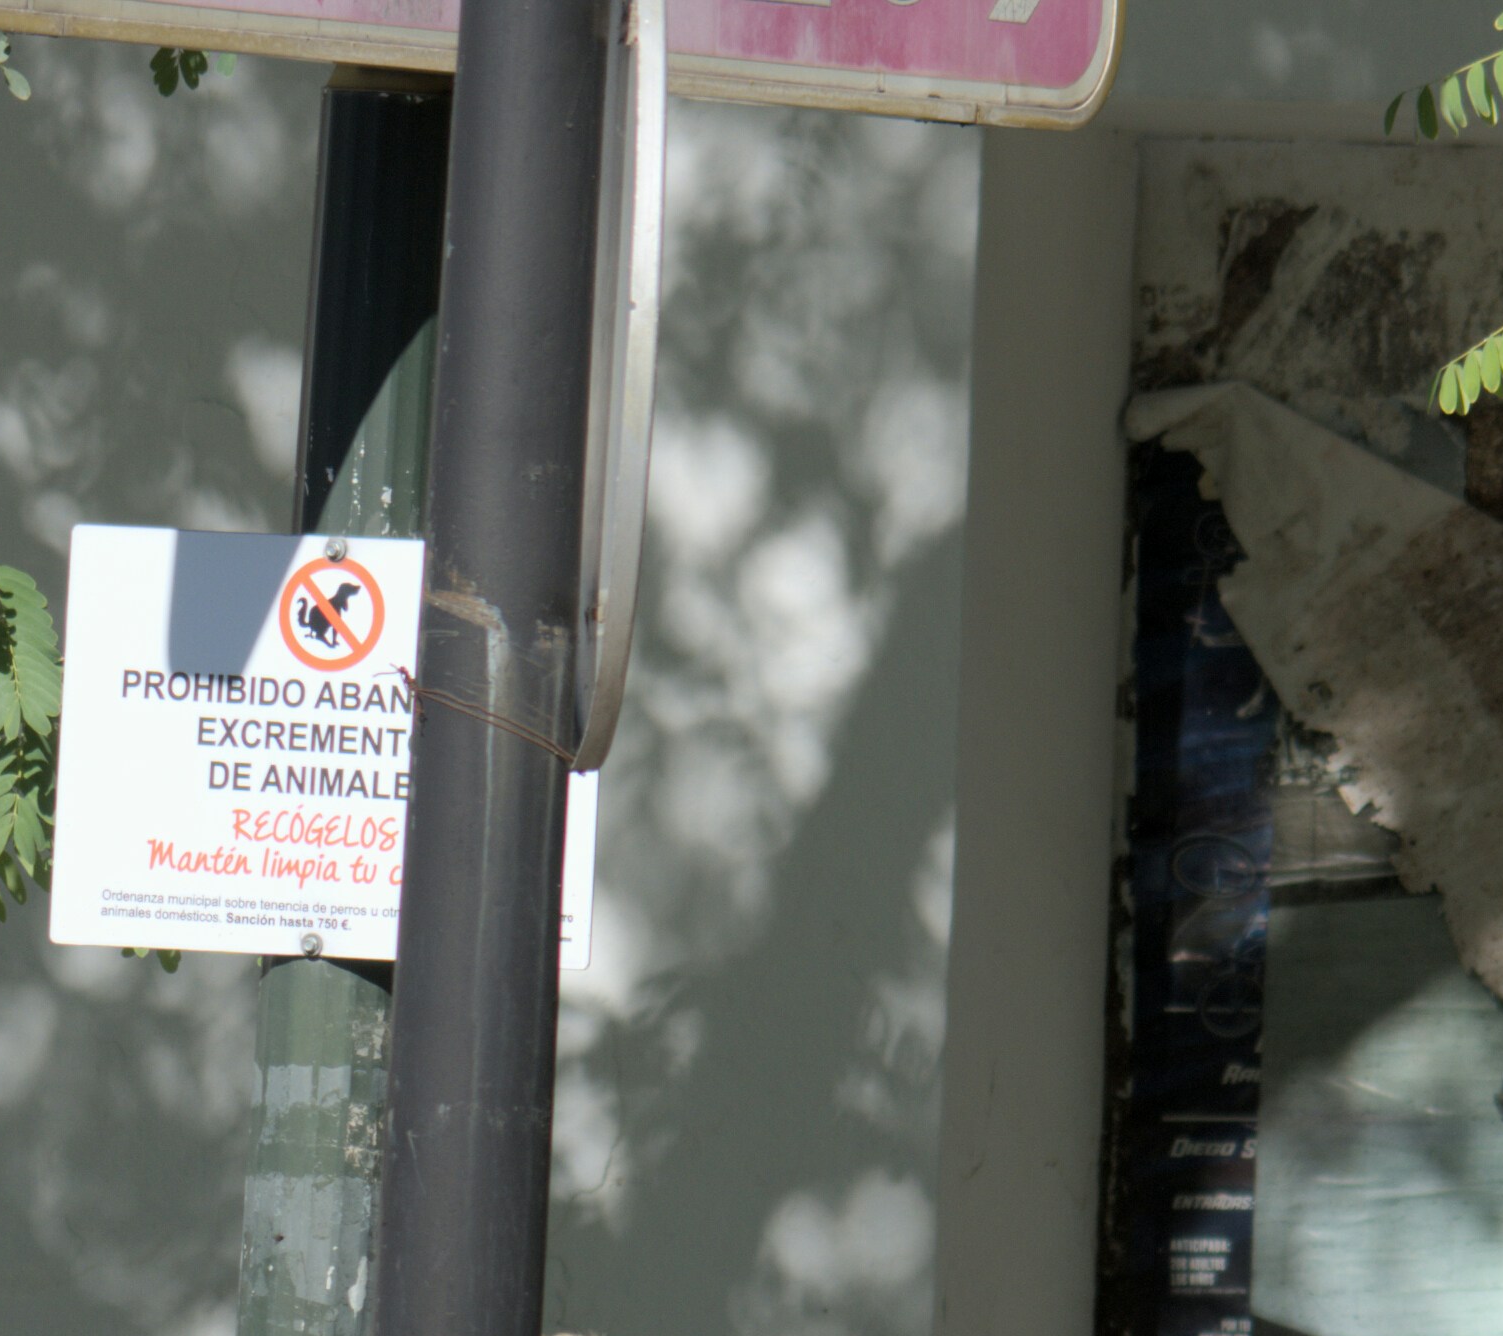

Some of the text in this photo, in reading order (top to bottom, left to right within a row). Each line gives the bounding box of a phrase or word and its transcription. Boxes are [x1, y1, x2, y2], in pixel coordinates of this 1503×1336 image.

[122, 668, 305, 709] PROHIBIDO
[197, 716, 412, 757] EXCREMENT
[208, 761, 252, 792] DE
[233, 804, 400, 852] RECÓGELOS
[147, 839, 252, 877] Mantén
[262, 848, 341, 890] limpia
[350, 856, 377, 885] tu
[101, 905, 152, 920] animales
[154, 907, 220, 924] domésticos.
[226, 911, 276, 928] Sanción
[279, 914, 314, 928] hasta
[317, 917, 338, 930] 750
[102, 889, 165, 905] Ordenanza
[168, 893, 222, 911] municipal
[225, 896, 257, 909] sobre
[260, 898, 309, 913] tenencia
[312, 900, 327, 913] de
[330, 902, 367, 919] perros
